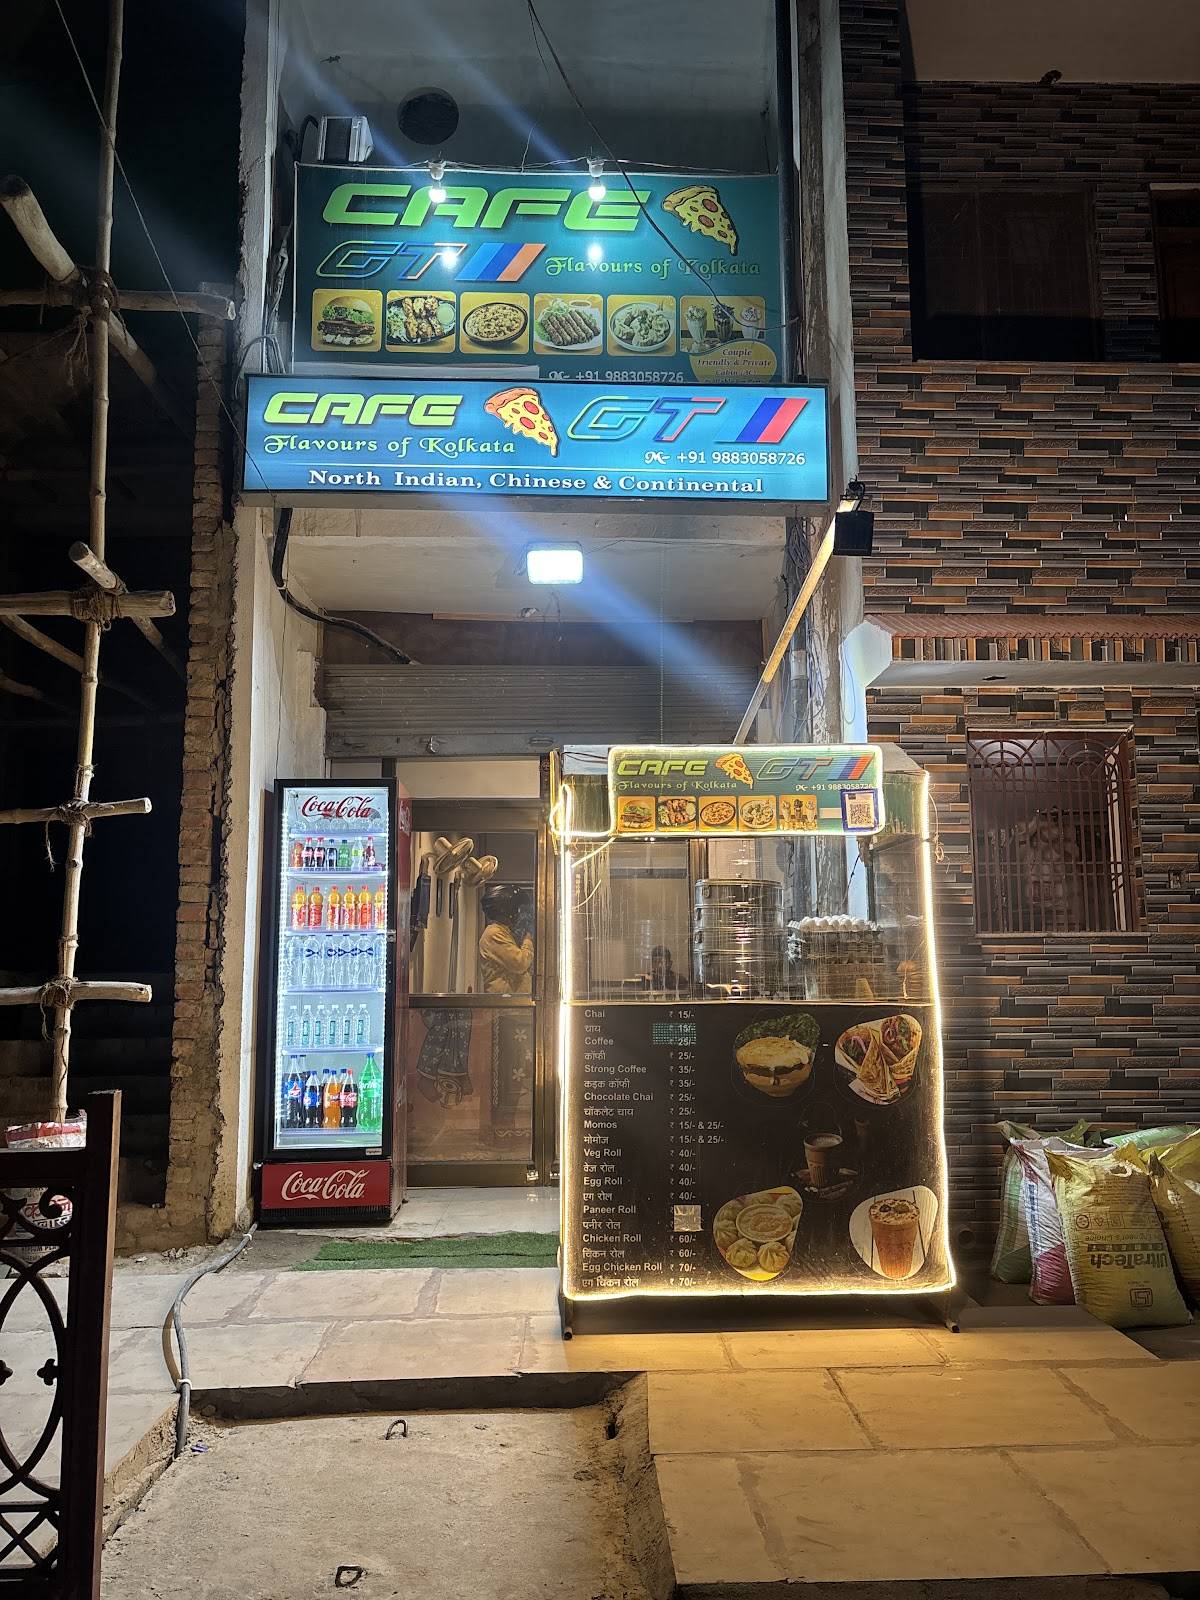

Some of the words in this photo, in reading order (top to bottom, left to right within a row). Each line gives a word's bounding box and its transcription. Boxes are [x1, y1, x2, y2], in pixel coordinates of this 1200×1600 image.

[322, 183, 651, 231] CAFE
[545, 257, 642, 276] Flavours
[651, 259, 672, 279] of
[678, 259, 760, 280] Kolkata
[722, 348, 752, 357] Couple
[697, 359, 730, 368] Friendly
[742, 360, 771, 368] Private
[576, 370, 599, 381] +91
[605, 371, 684, 382] 9883058726
[263, 392, 463, 426] CAFE
[567, 396, 727, 442] GT
[264, 435, 378, 453] Flavours
[387, 437, 412, 457] of
[420, 437, 515, 458] Kolkata
[676, 451, 706, 464] +91
[712, 451, 806, 465] 9883058726
[309, 470, 381, 485] North
[395, 471, 482, 488] Indian,
[489, 472, 586, 489] Chinese
[593, 476, 612, 489] &
[618, 476, 763, 492] Continental
[617, 760, 708, 777] CAFE
[617, 781, 672, 790] Flavours
[677, 781, 688, 792] of
[691, 781, 738, 791] Kolkata
[302, 795, 374, 819] Coca-Cola
[584, 1009, 605, 1018] Chai
[678, 1011, 695, 1019] 15/-
[584, 1037, 614, 1046] Coffee
[678, 1051, 695, 1060] 25/-
[584, 1064, 615, 1074] Strong
[617, 1064, 647, 1073] Coffee
[678, 1065, 695, 1074] 35/-
[678, 1080, 695, 1088] 35/-
[584, 1092, 630, 1101] Chocolate
[632, 1092, 654, 1101] Chai
[678, 1093, 695, 1102] 25/-
[678, 1107, 695, 1116] 25/-
[584, 1120, 618, 1129] Momos
[679, 1121, 695, 1130] 15/-
[698, 1121, 705, 1129] &
[707, 1121, 724, 1130] 25/-
[679, 1135, 695, 1144] 15/-
[698, 1136, 705, 1144] &
[707, 1135, 724, 1144] 25/-
[583, 1148, 601, 1158] Veg
[603, 1148, 622, 1157] Roll
[678, 1149, 696, 1158] 40/-
[678, 1163, 696, 1172] 40/-
[281, 1169, 370, 1200] Coca-Cola
[583, 1177, 602, 1187] Egg
[604, 1177, 623, 1185] Roll
[678, 1177, 696, 1186] 40/-
[678, 1191, 696, 1200] 40/-
[583, 1205, 615, 1214] Paneer
[618, 1205, 636, 1214] Roll
[582, 1233, 620, 1243] Chicken
[623, 1233, 642, 1242] Roll
[678, 1235, 696, 1244] 60/-
[678, 1249, 696, 1258] 60/-
[1091, 1253, 1168, 1269] UltraTech
[582, 1263, 601, 1272] Egg
[603, 1262, 641, 1271] Chicken
[643, 1262, 662, 1271] Roll
[679, 1263, 696, 1272] 70/-
[679, 1277, 696, 1287] 70/-
